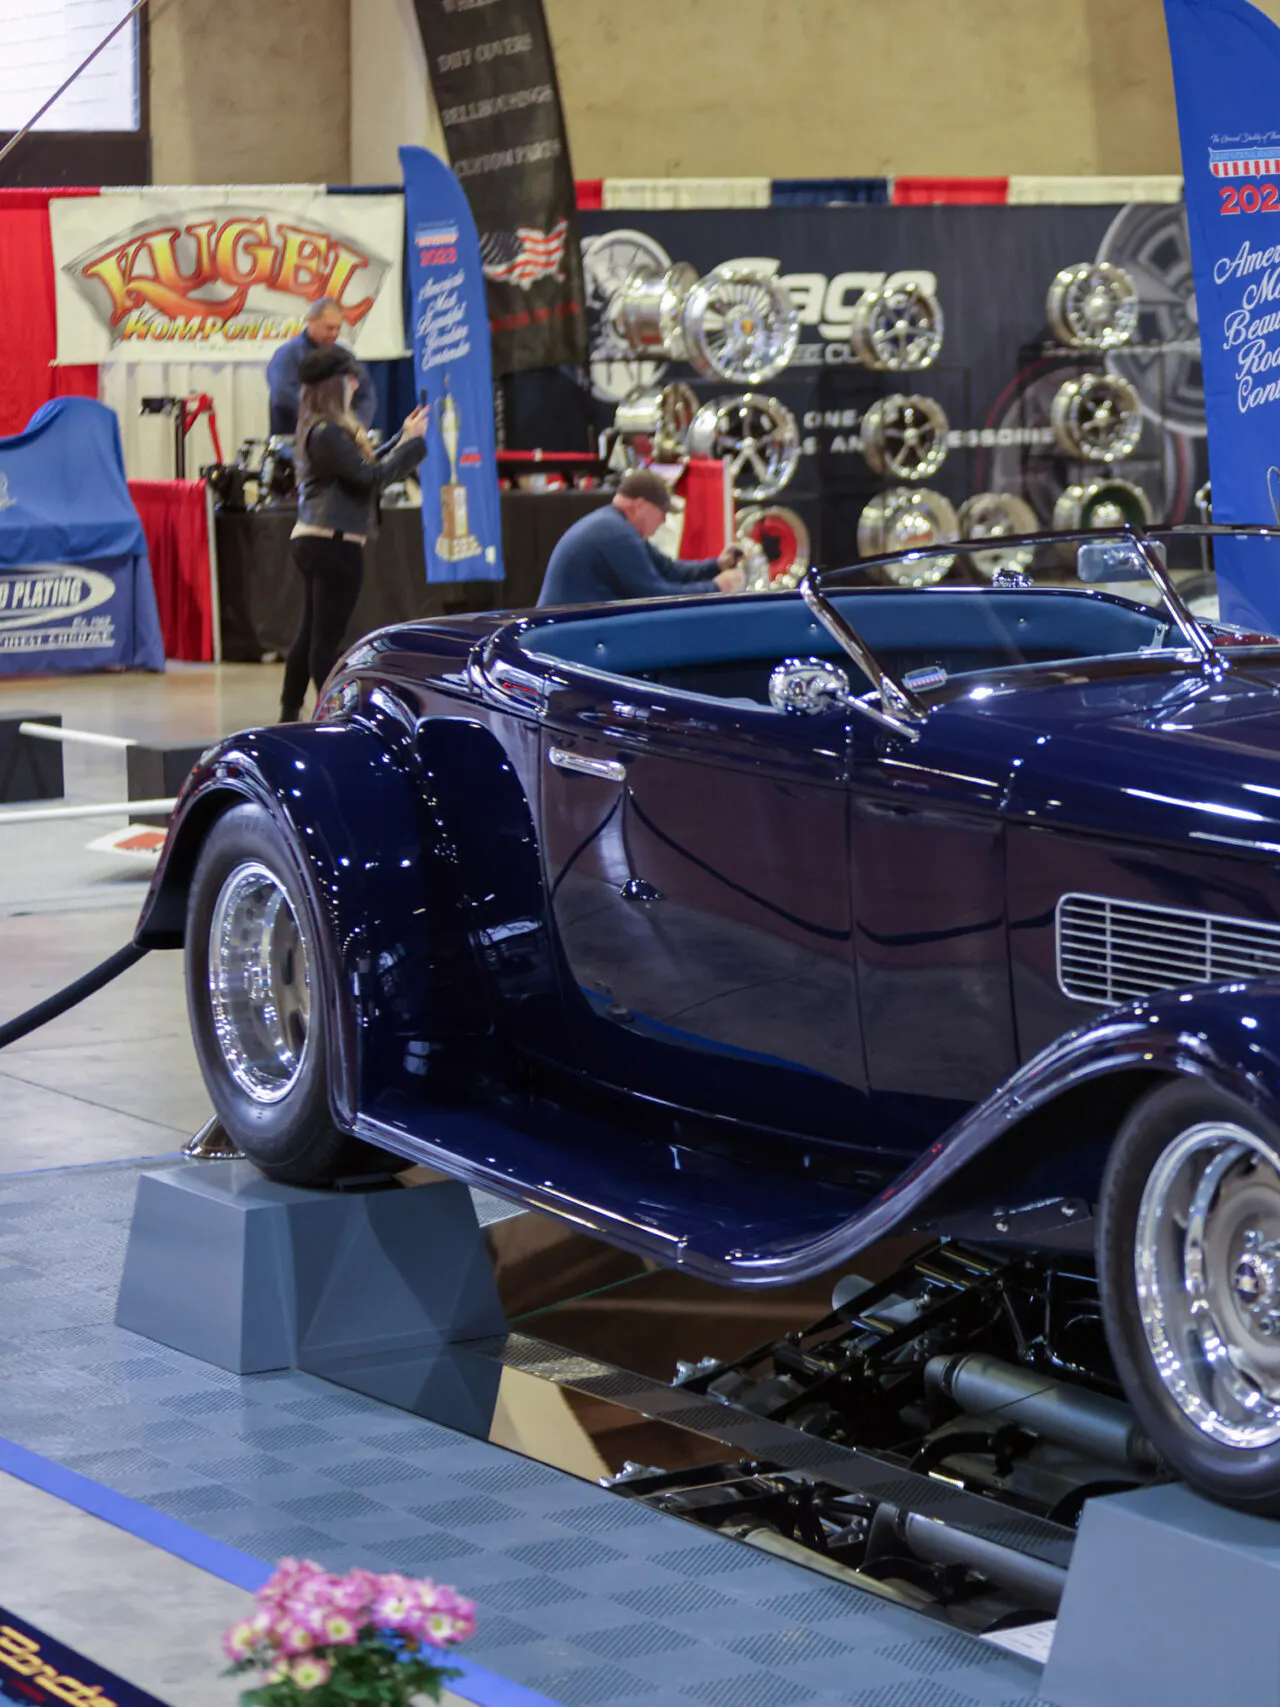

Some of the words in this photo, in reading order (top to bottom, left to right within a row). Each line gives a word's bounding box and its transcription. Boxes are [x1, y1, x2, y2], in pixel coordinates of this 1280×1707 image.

[83, 217, 374, 326] KUGEL
[120, 312, 305, 342] KOMPONEN
[11, 579, 82, 609] PLATING
